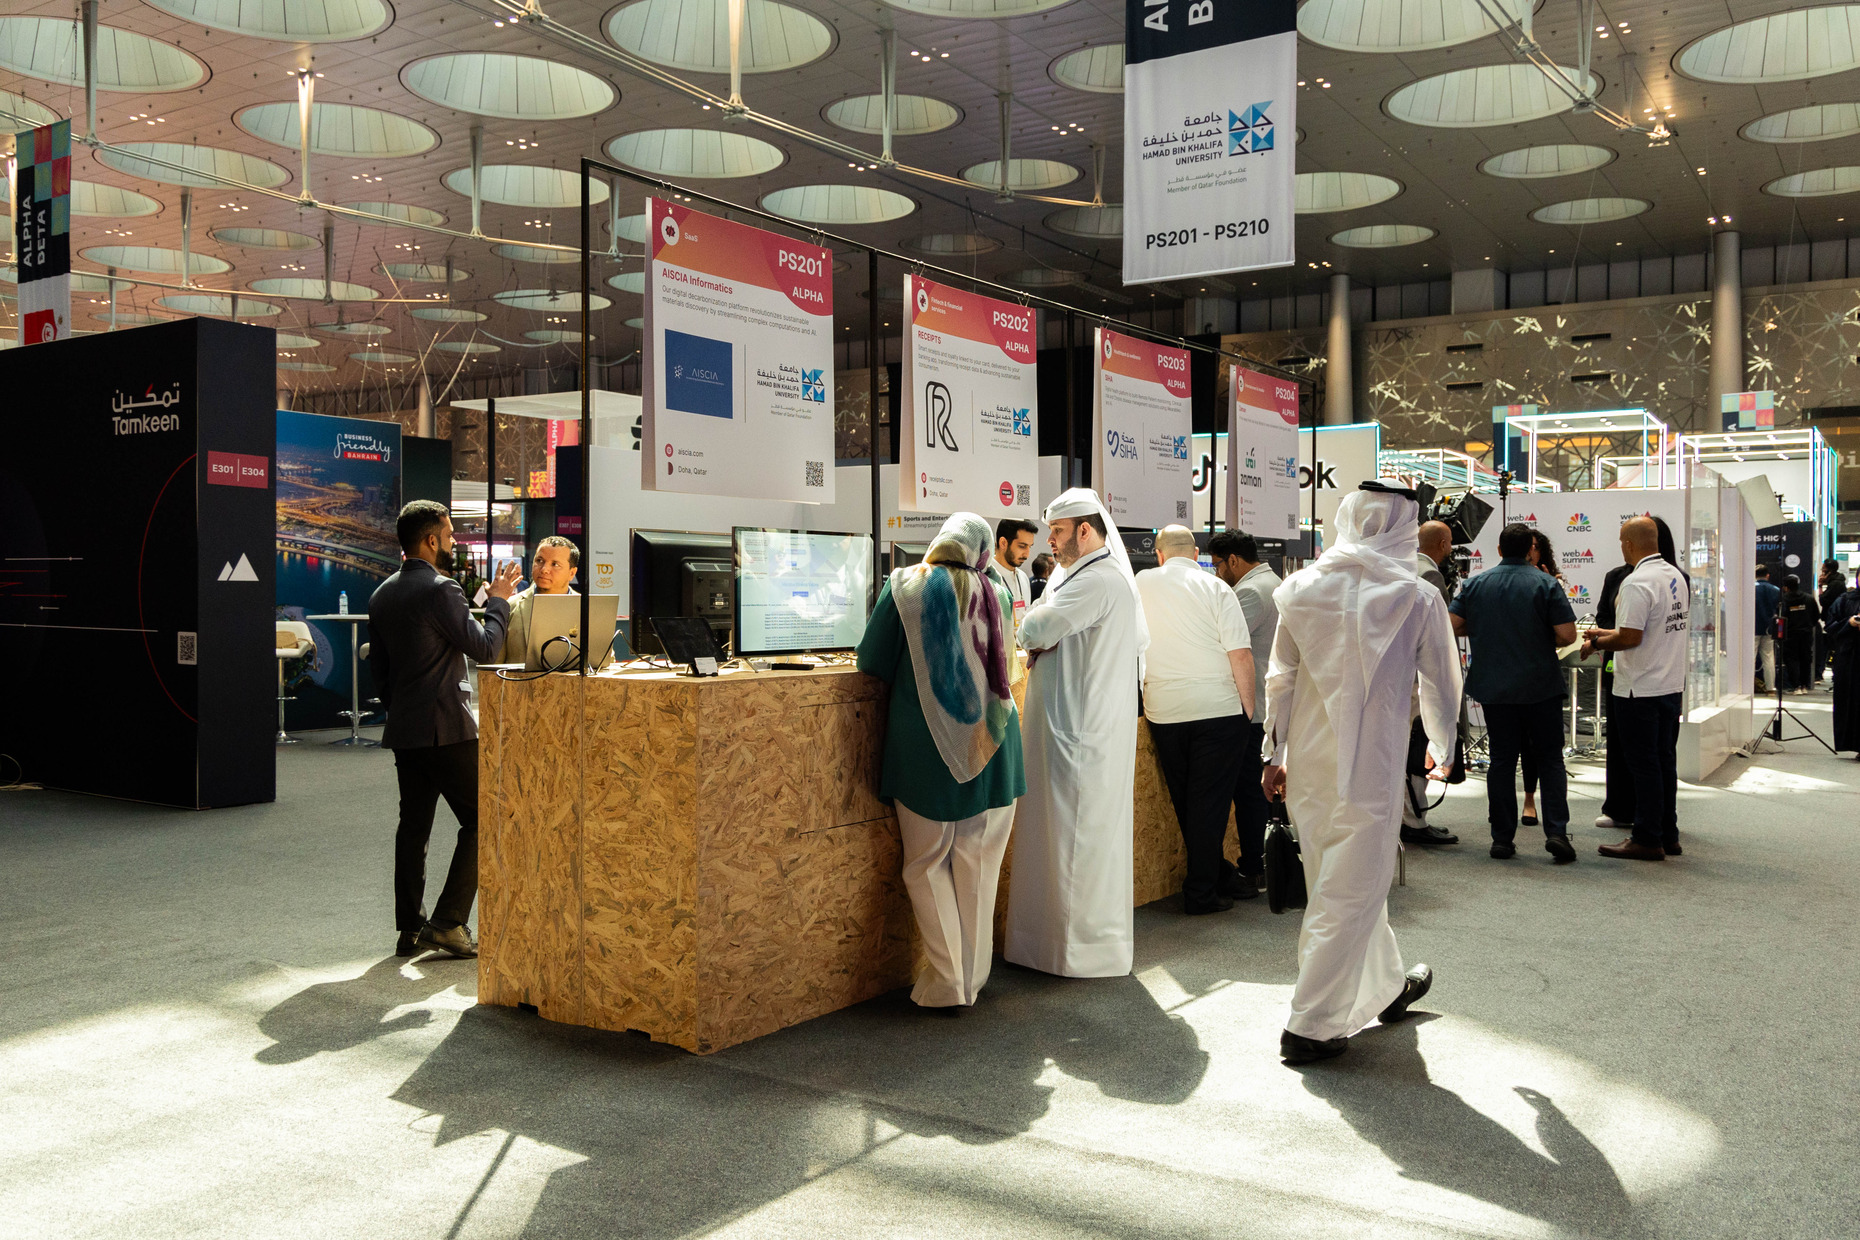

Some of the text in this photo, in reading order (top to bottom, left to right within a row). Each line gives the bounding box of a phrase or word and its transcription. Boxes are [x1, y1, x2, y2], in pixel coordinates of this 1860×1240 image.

[1184, 112, 1222, 127] جامعة
[1143, 127, 1222, 147] حمد بن خليفة
[1142, 140, 1223, 160] HAMAD BIN KHALIFA
[1175, 151, 1223, 166] UNIVERSITY
[1167, 184, 1190, 194] Member
[1199, 181, 1213, 190] Qatar
[1215, 176, 1247, 187] Foundation
[22, 195, 33, 267] ALPHA
[37, 209, 46, 265] BETA
[684, 232, 698, 243] SaaS
[1146, 228, 1198, 250] PS201
[1214, 218, 1270, 241] PS210
[778, 249, 823, 278] PS201
[662, 267, 733, 295] AISCIA Informatics
[792, 286, 824, 304] ALPHA
[661, 285, 809, 326] Our digital decarbonization platform revolutionizes sustainable
[662, 296, 684, 307] materials
[685, 301, 709, 315] discovery
[710, 307, 716, 316] by
[717, 309, 747, 323] streamlining
[747, 316, 768, 327] complex
[769, 320, 800, 333] computations
[801, 327, 810, 335] and
[993, 310, 1029, 333] PS202
[918, 330, 942, 344] RECEIPTS
[1005, 340, 1030, 354] ALPHA
[1157, 354, 1185, 371] PS203
[757, 380, 772, 388] HAMAD
[781, 383, 799, 392] KHALIFA
[1167, 378, 1186, 390] ALPHA
[112, 382, 180, 413] تمكين
[775, 391, 799, 400] UNIVERSITY
[1275, 386, 1295, 402] PS204
[1282, 408, 1295, 417] ALPHA
[112, 414, 180, 435] Tamkeen
[344, 433, 373, 441] BUSINESS
[333, 433, 391, 463] friendly
[678, 447, 704, 459] aiscia.com
[1119, 444, 1138, 460] SIHA
[347, 452, 378, 460] BAHRAIN
[212, 464, 265, 477] E301 E304
[678, 465, 707, 476] Doha, Qatar
[1240, 473, 1262, 488] zaman
[887, 515, 902, 528] #1
[1507, 513, 1525, 521] web
[1566, 525, 1592, 533] CNBC
[1562, 549, 1580, 558] web
[1562, 556, 1594, 564] summit
